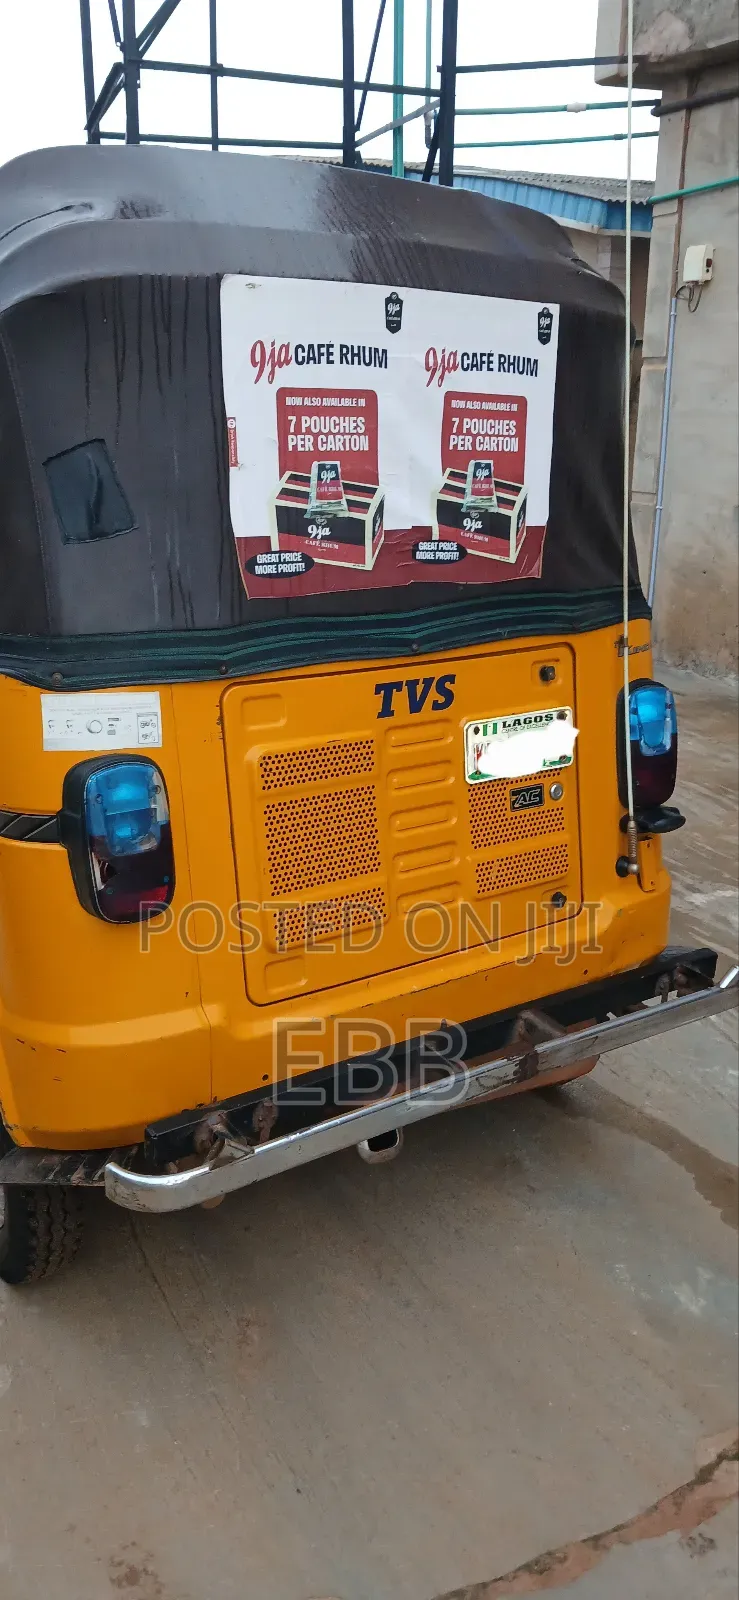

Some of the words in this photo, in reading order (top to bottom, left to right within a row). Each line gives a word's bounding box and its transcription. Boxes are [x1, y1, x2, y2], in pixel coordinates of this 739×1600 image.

[250, 339, 293, 384] 9ja
[294, 340, 335, 366] CAFÉ
[339, 344, 388, 369] RHUM
[424, 346, 460, 388] 9ja
[460, 350, 494, 372] CAFÉ
[498, 354, 538, 378] RHUM
[285, 396, 302, 406] NOW
[304, 397, 321, 406] ALSO
[322, 397, 357, 407] AVAILABLE
[358, 398, 366, 407] IN
[451, 400, 466, 408] NOW
[466, 400, 481, 409] ALSO
[482, 401, 511, 412] AVAILABLE
[511, 403, 518, 412] IN
[288, 416, 297, 433] 7
[302, 416, 366, 434] POUCHES
[452, 418, 460, 434] 7
[463, 418, 517, 436] POUCHES
[288, 435, 314, 452] PER
[318, 435, 369, 452] CARTON
[449, 435, 472, 451] PER
[476, 436, 519, 452] CARTON
[320, 469, 336, 484] 9ja
[308, 524, 331, 540] 9ja
[462, 518, 482, 533] 9ja
[418, 542, 438, 550] GREAT
[438, 542, 458, 551] PRICE
[256, 554, 280, 564] GREAT
[280, 552, 302, 562] PRICE
[416, 551, 435, 560] MORE
[436, 552, 460, 561] PROFIT!
[254, 564, 278, 575] MORE
[278, 562, 306, 574] PROFIT!
[374, 674, 456, 719] TVS
[502, 713, 554, 729] LAGOS
[514, 788, 542, 808] AC
